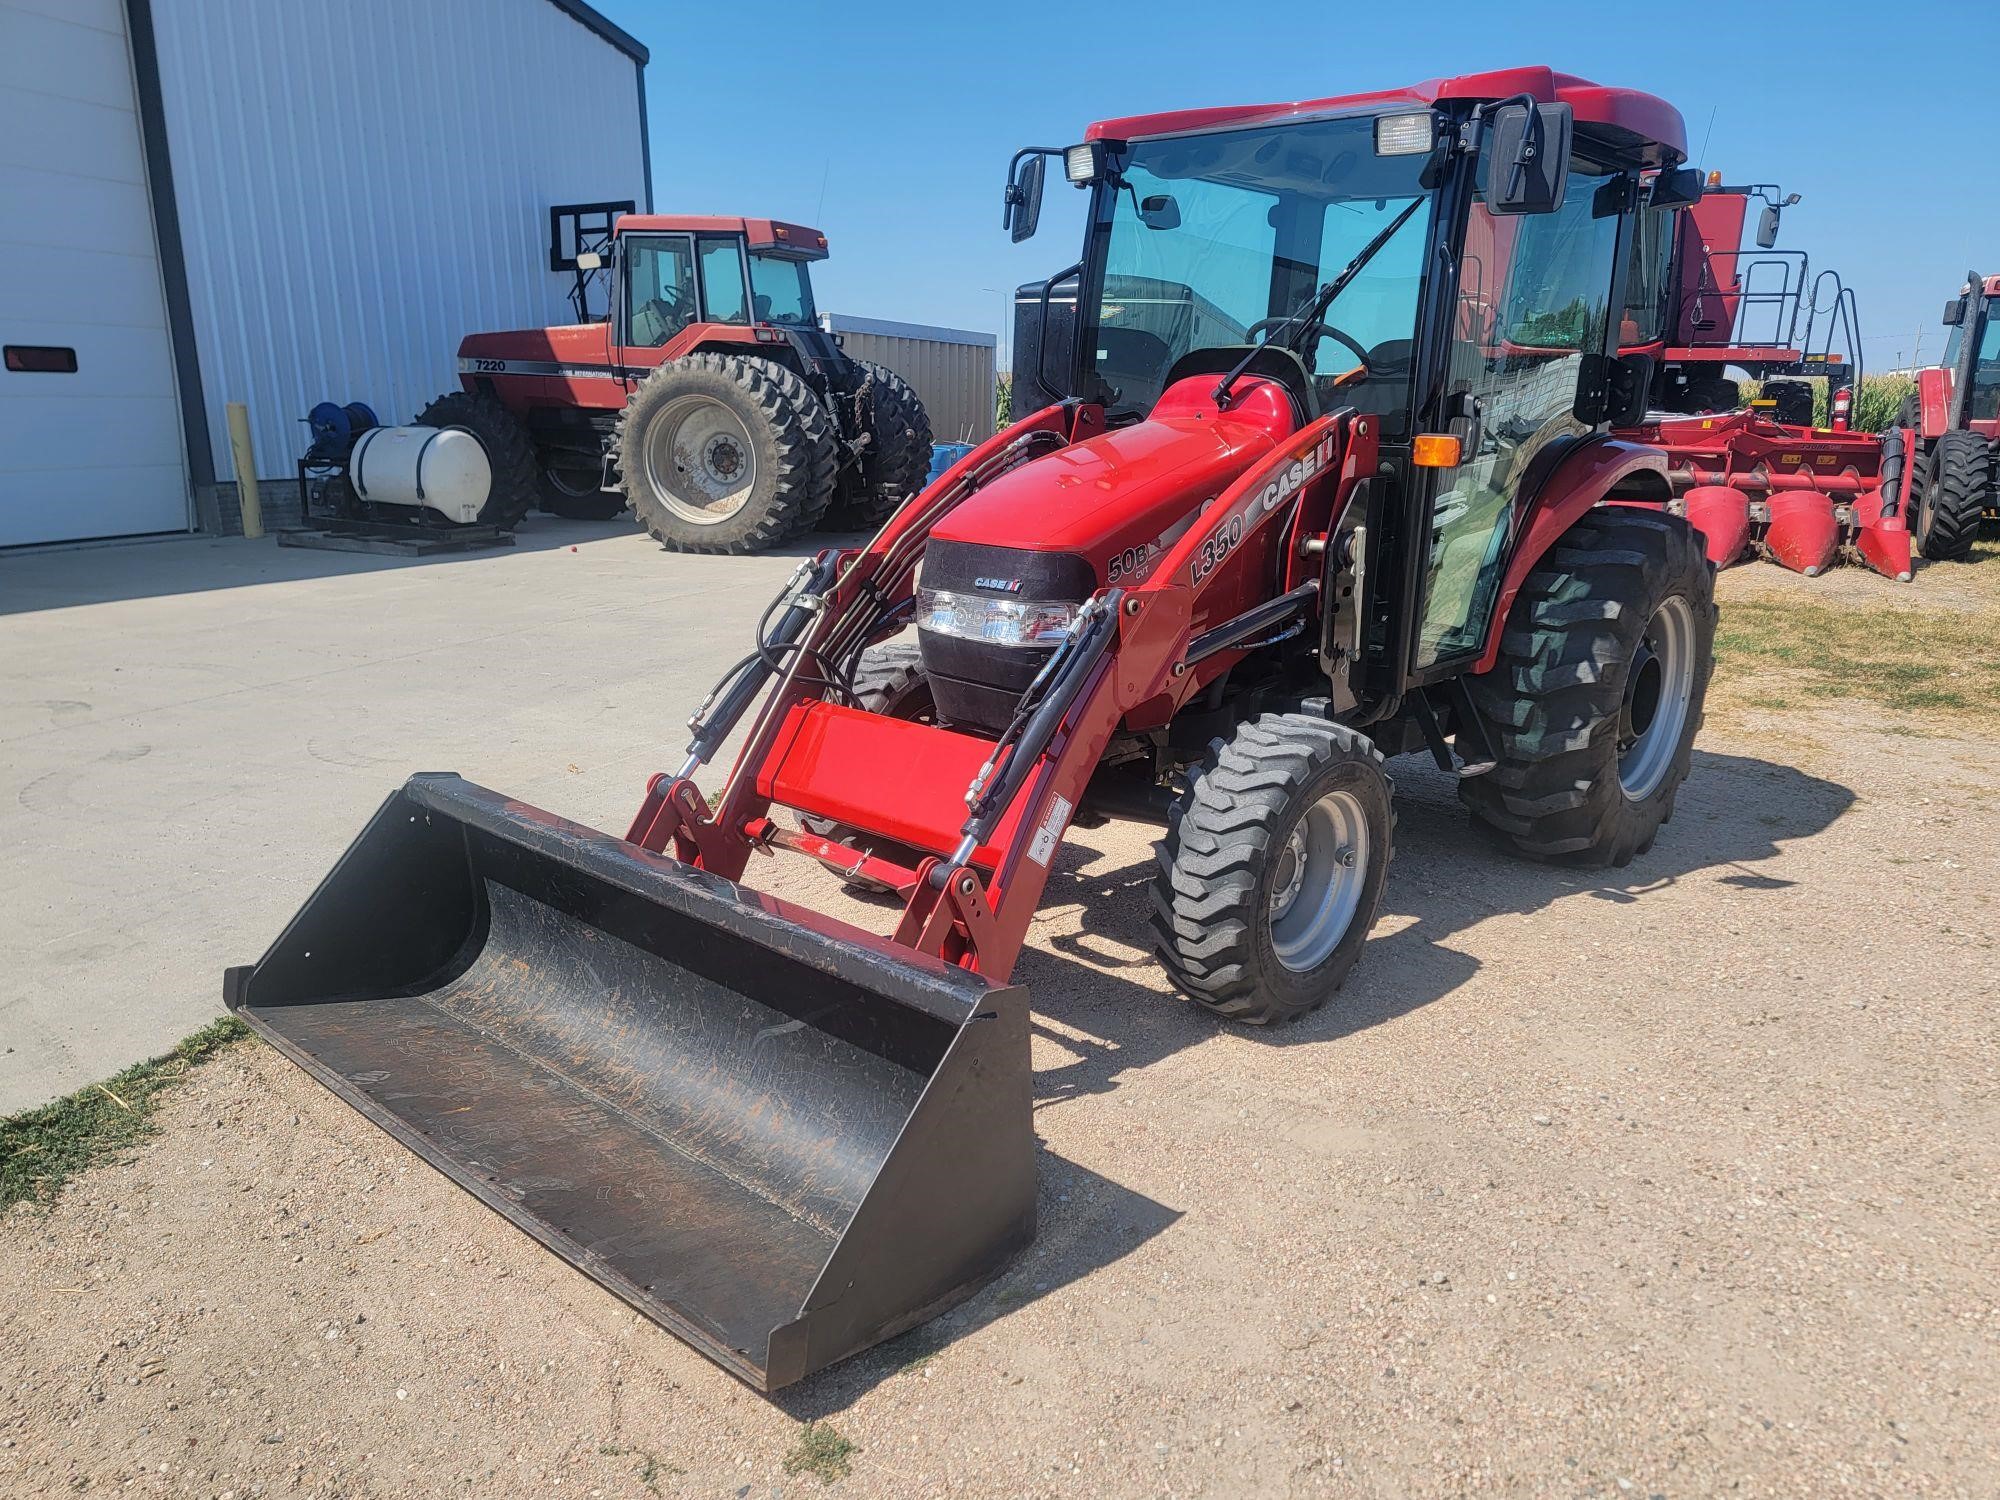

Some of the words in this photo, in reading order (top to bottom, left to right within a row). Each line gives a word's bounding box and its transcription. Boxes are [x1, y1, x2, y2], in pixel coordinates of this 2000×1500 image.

[475, 359, 506, 372] 7220
[1190, 513, 1243, 589] L350
[1262, 450, 1316, 512] CASE
[1107, 543, 1149, 584] 50B
[1135, 566, 1150, 580] CVT
[974, 577, 1007, 590] CASE
